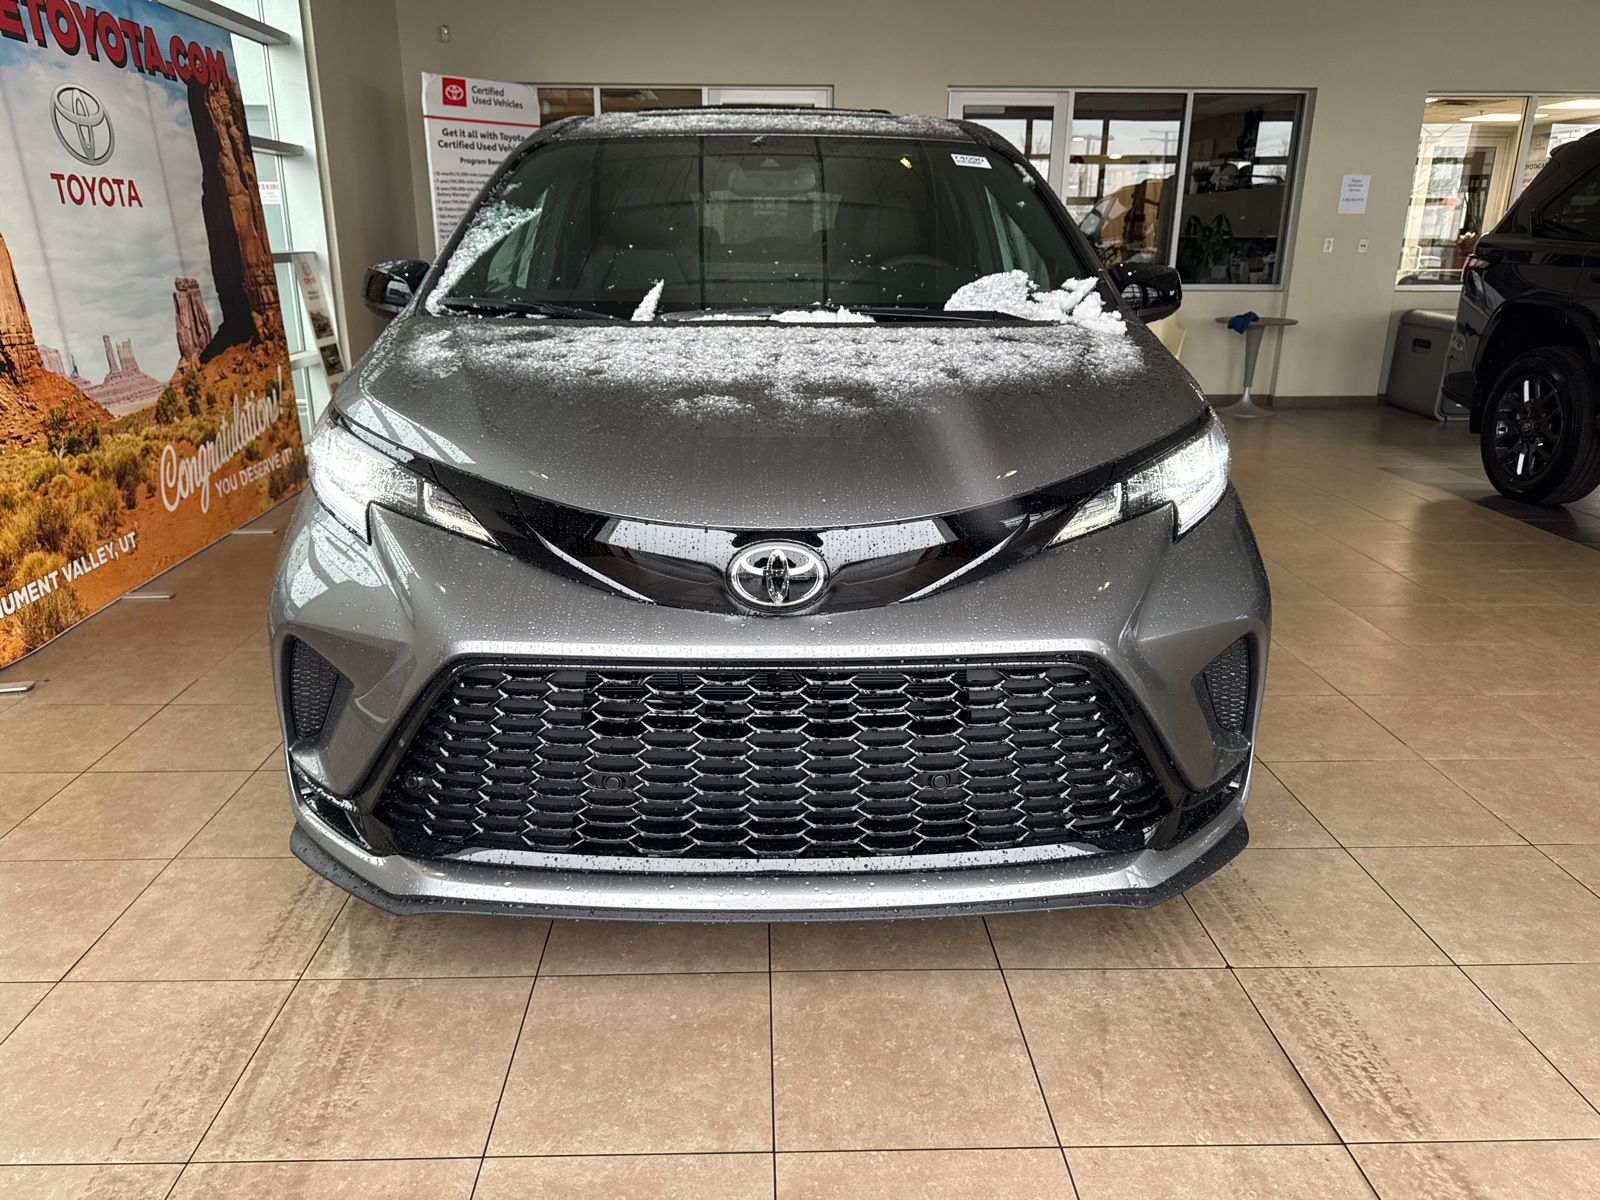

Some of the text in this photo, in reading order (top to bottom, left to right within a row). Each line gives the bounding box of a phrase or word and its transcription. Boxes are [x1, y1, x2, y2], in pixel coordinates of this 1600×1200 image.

[471, 85, 505, 97] Certified
[472, 96, 523, 109] Used Vehicles
[442, 128, 525, 143] Get it all with Toyota
[437, 140, 475, 150] Certified
[476, 142, 497, 151] Used
[460, 156, 487, 166] Program
[50, 173, 143, 208] TOYOTA
[160, 364, 284, 514] Congratulations!
[215, 447, 293, 497] YOU DESERVE IT!
[61, 541, 119, 583] VALLEY,
[118, 531, 136, 553] UT
